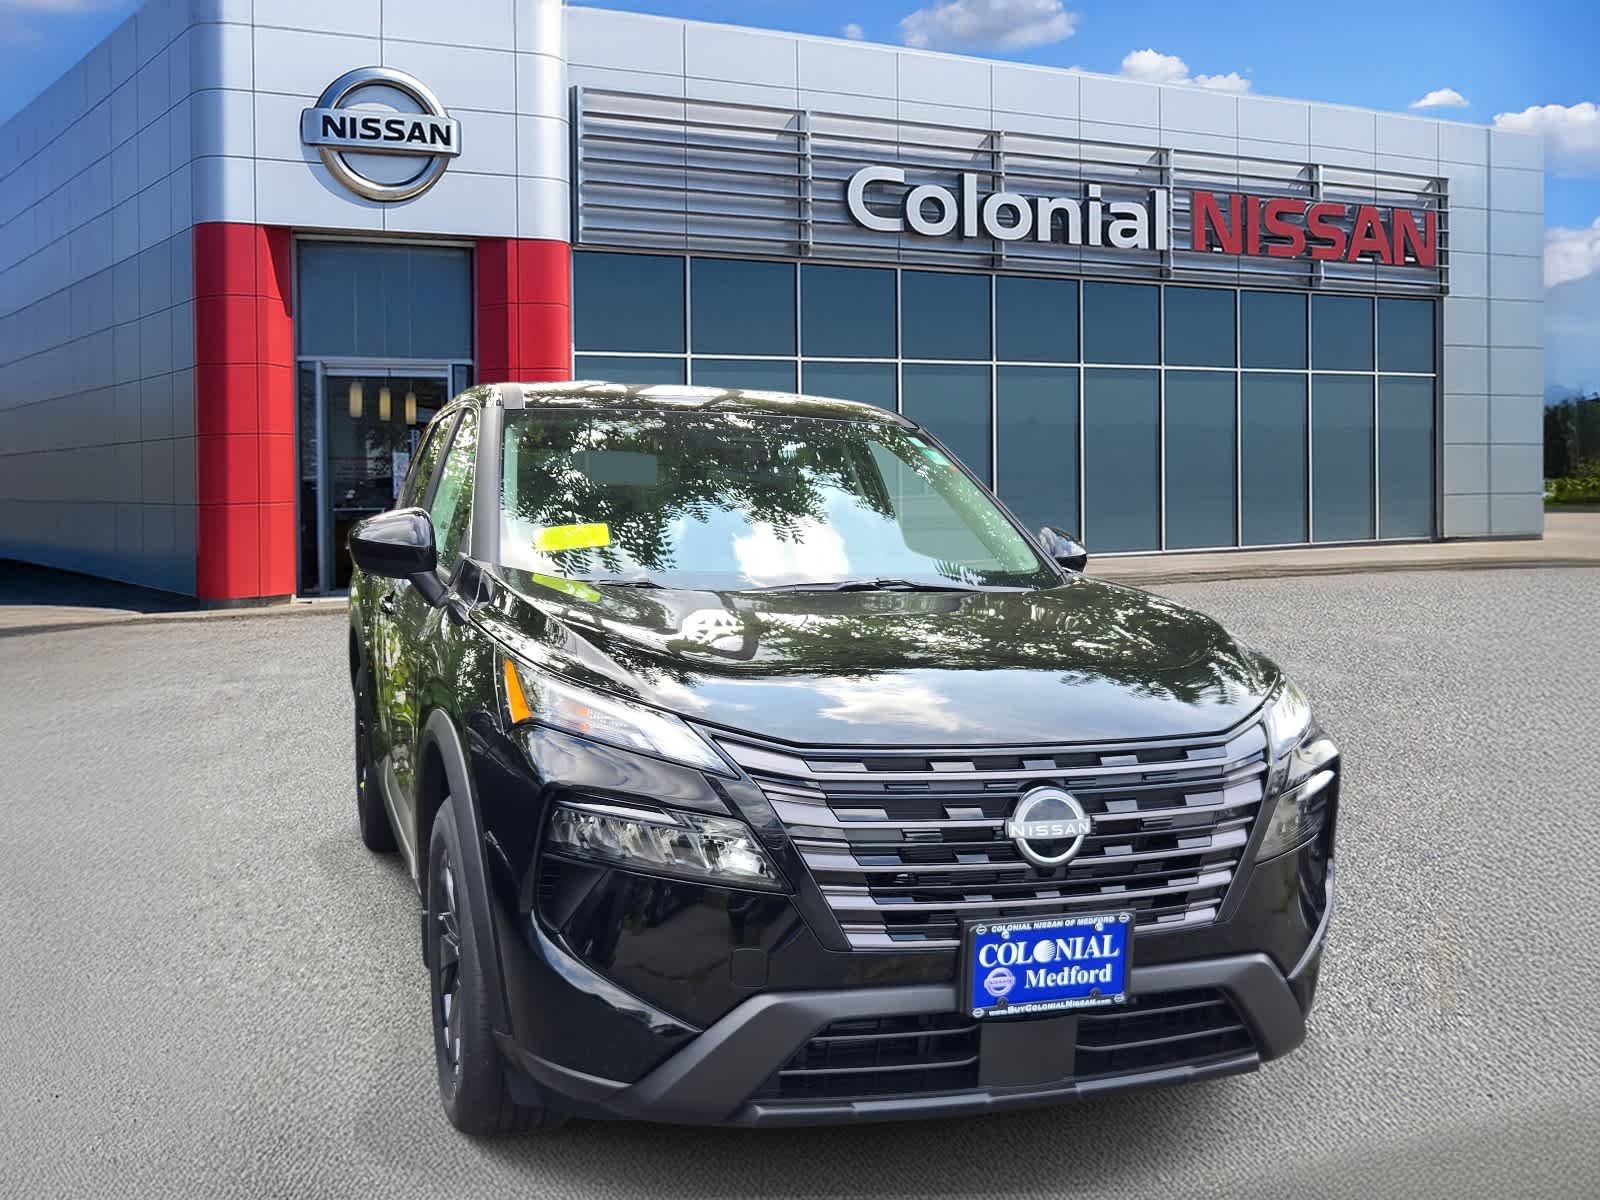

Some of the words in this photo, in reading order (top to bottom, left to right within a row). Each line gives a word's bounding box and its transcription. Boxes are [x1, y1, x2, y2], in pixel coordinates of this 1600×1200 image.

[322, 115, 452, 146] NISSAN
[847, 165, 1167, 250] Colonial
[1191, 191, 1435, 266] NISSAN
[1010, 822, 1089, 837] NISSAN
[991, 922, 1032, 933] COLONIAL
[1033, 919, 1063, 929] NISSAN
[1065, 918, 1075, 927] OF
[1077, 915, 1115, 926] MEDFORD
[978, 934, 1121, 968] COLONIAL
[1023, 963, 1113, 989] Medford
